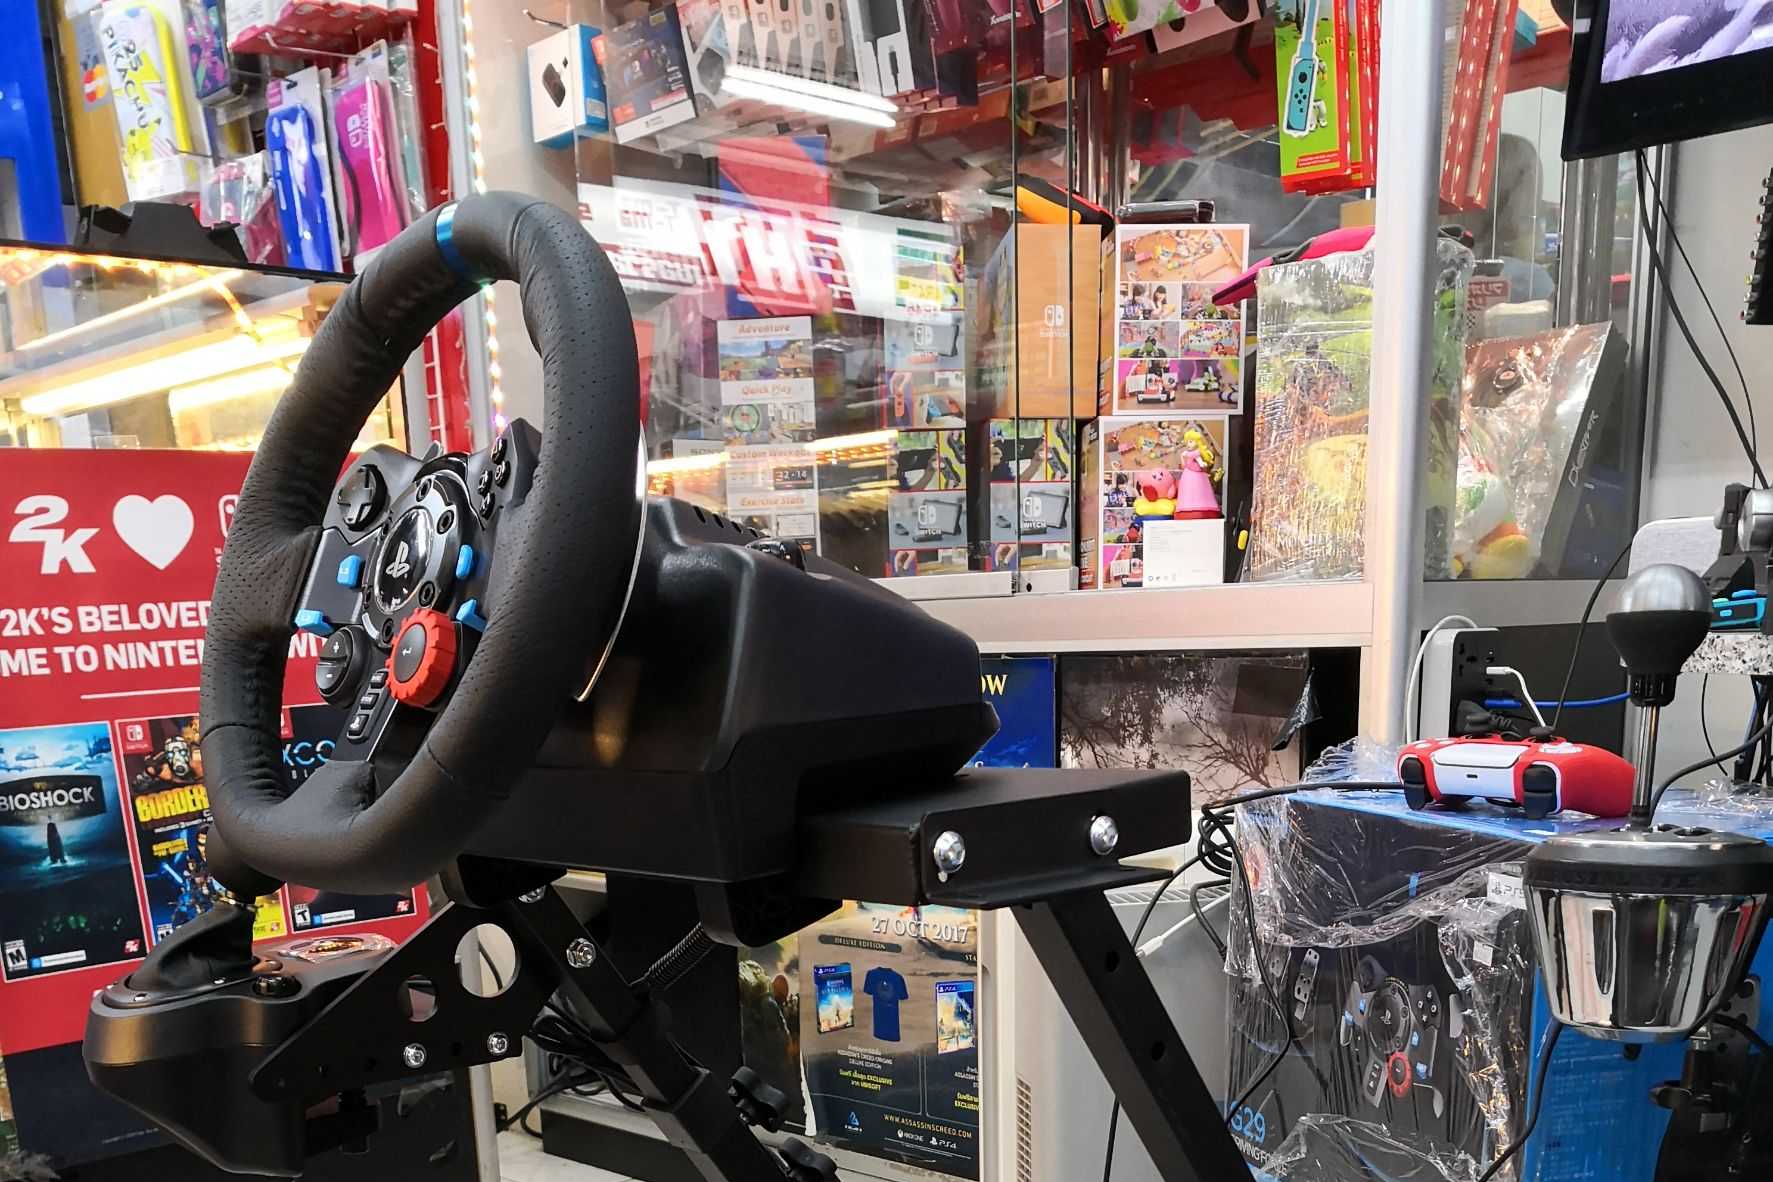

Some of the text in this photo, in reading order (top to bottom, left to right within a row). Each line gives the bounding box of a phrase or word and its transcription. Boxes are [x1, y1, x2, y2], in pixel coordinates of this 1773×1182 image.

[101, 26, 150, 130] PIKACHU
[9, 494, 100, 575] 2K
[1, 606, 74, 638] 2K'S
[54, 645, 99, 674] TO
[0, 785, 96, 812] BIOSHOCK
[135, 783, 211, 822] BORDER
[872, 917, 969, 944] 27 OCT 2017
[884, 1113, 973, 1139] WWW.ASSASSINSCREED.COM
